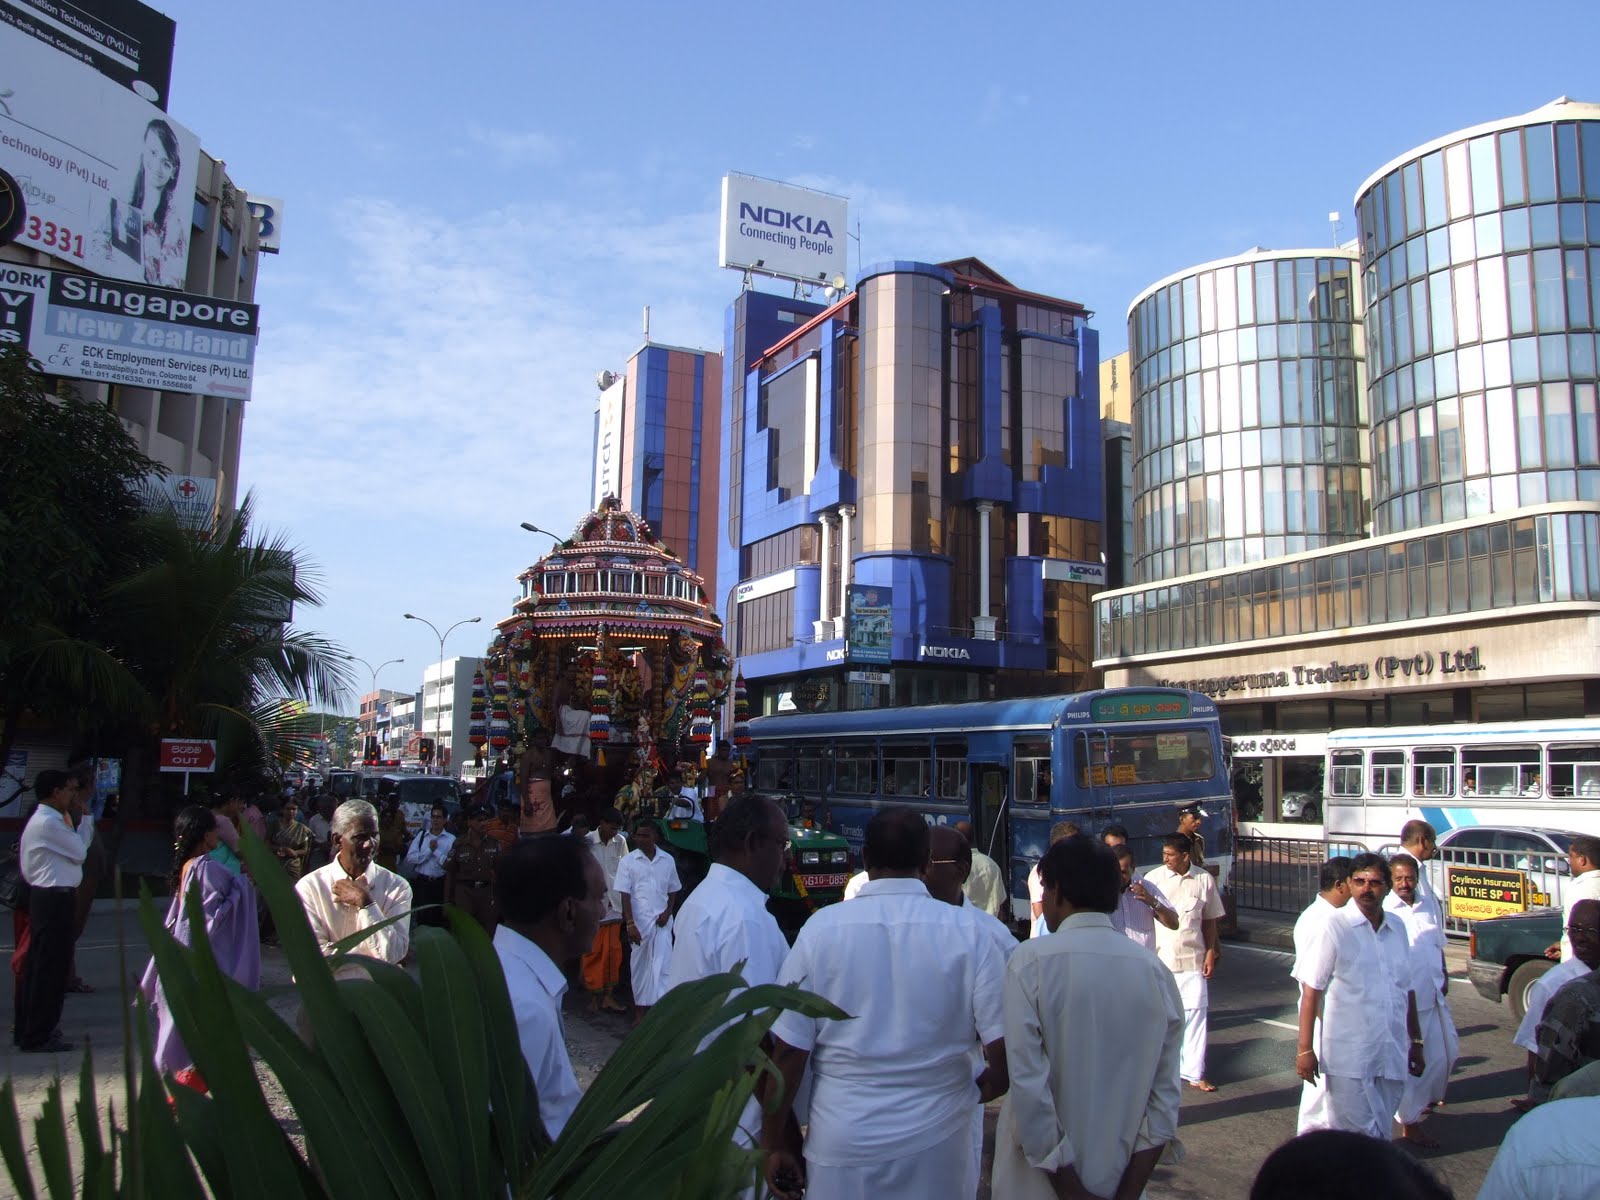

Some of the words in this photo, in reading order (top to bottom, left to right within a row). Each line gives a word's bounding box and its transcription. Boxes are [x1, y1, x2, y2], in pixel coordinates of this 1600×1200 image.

[32, 0, 58, 15] ation
[60, 8, 105, 42] Technology
[106, 34, 125, 53] (Pvt)
[126, 45, 140, 60] Ltd.
[56, 39, 83, 58] Colombo
[0, 130, 63, 169] echnology
[65, 159, 90, 183] (Pvt)
[92, 172, 110, 191] Ltd.
[740, 202, 833, 239] NOKIA
[19, 215, 84, 259] 3331
[739, 222, 796, 249] Connecting
[800, 235, 833, 255] People
[61, 277, 250, 327] Singapore
[57, 310, 123, 341] New
[131, 322, 248, 360] Zealand
[82, 345, 104, 358] ECK
[107, 349, 166, 367] Employment
[168, 358, 207, 374] Services
[209, 363, 231, 379] (Pvt)
[233, 367, 250, 379] Ltd.
[93, 361, 139, 375] Bambalapitiya
[159, 371, 187, 382] Colombo
[1069, 565, 1102, 577] NOKIA
[826, 649, 845, 661] NOK
[920, 645, 971, 660] NOKIA
[1292, 661, 1370, 686] Traders
[1374, 650, 1434, 680] (Pvt)
[1439, 646, 1486, 674] Ltd.
[1067, 711, 1091, 719] PHILIPS
[1192, 705, 1214, 713] PHILIPS
[172, 756, 199, 765] OUT
[840, 823, 863, 837] Tornado
[1450, 874, 1482, 886] Ceylinco
[1483, 877, 1520, 889] Insurance
[1453, 885, 1467, 896] ON
[1469, 887, 1488, 898] THE
